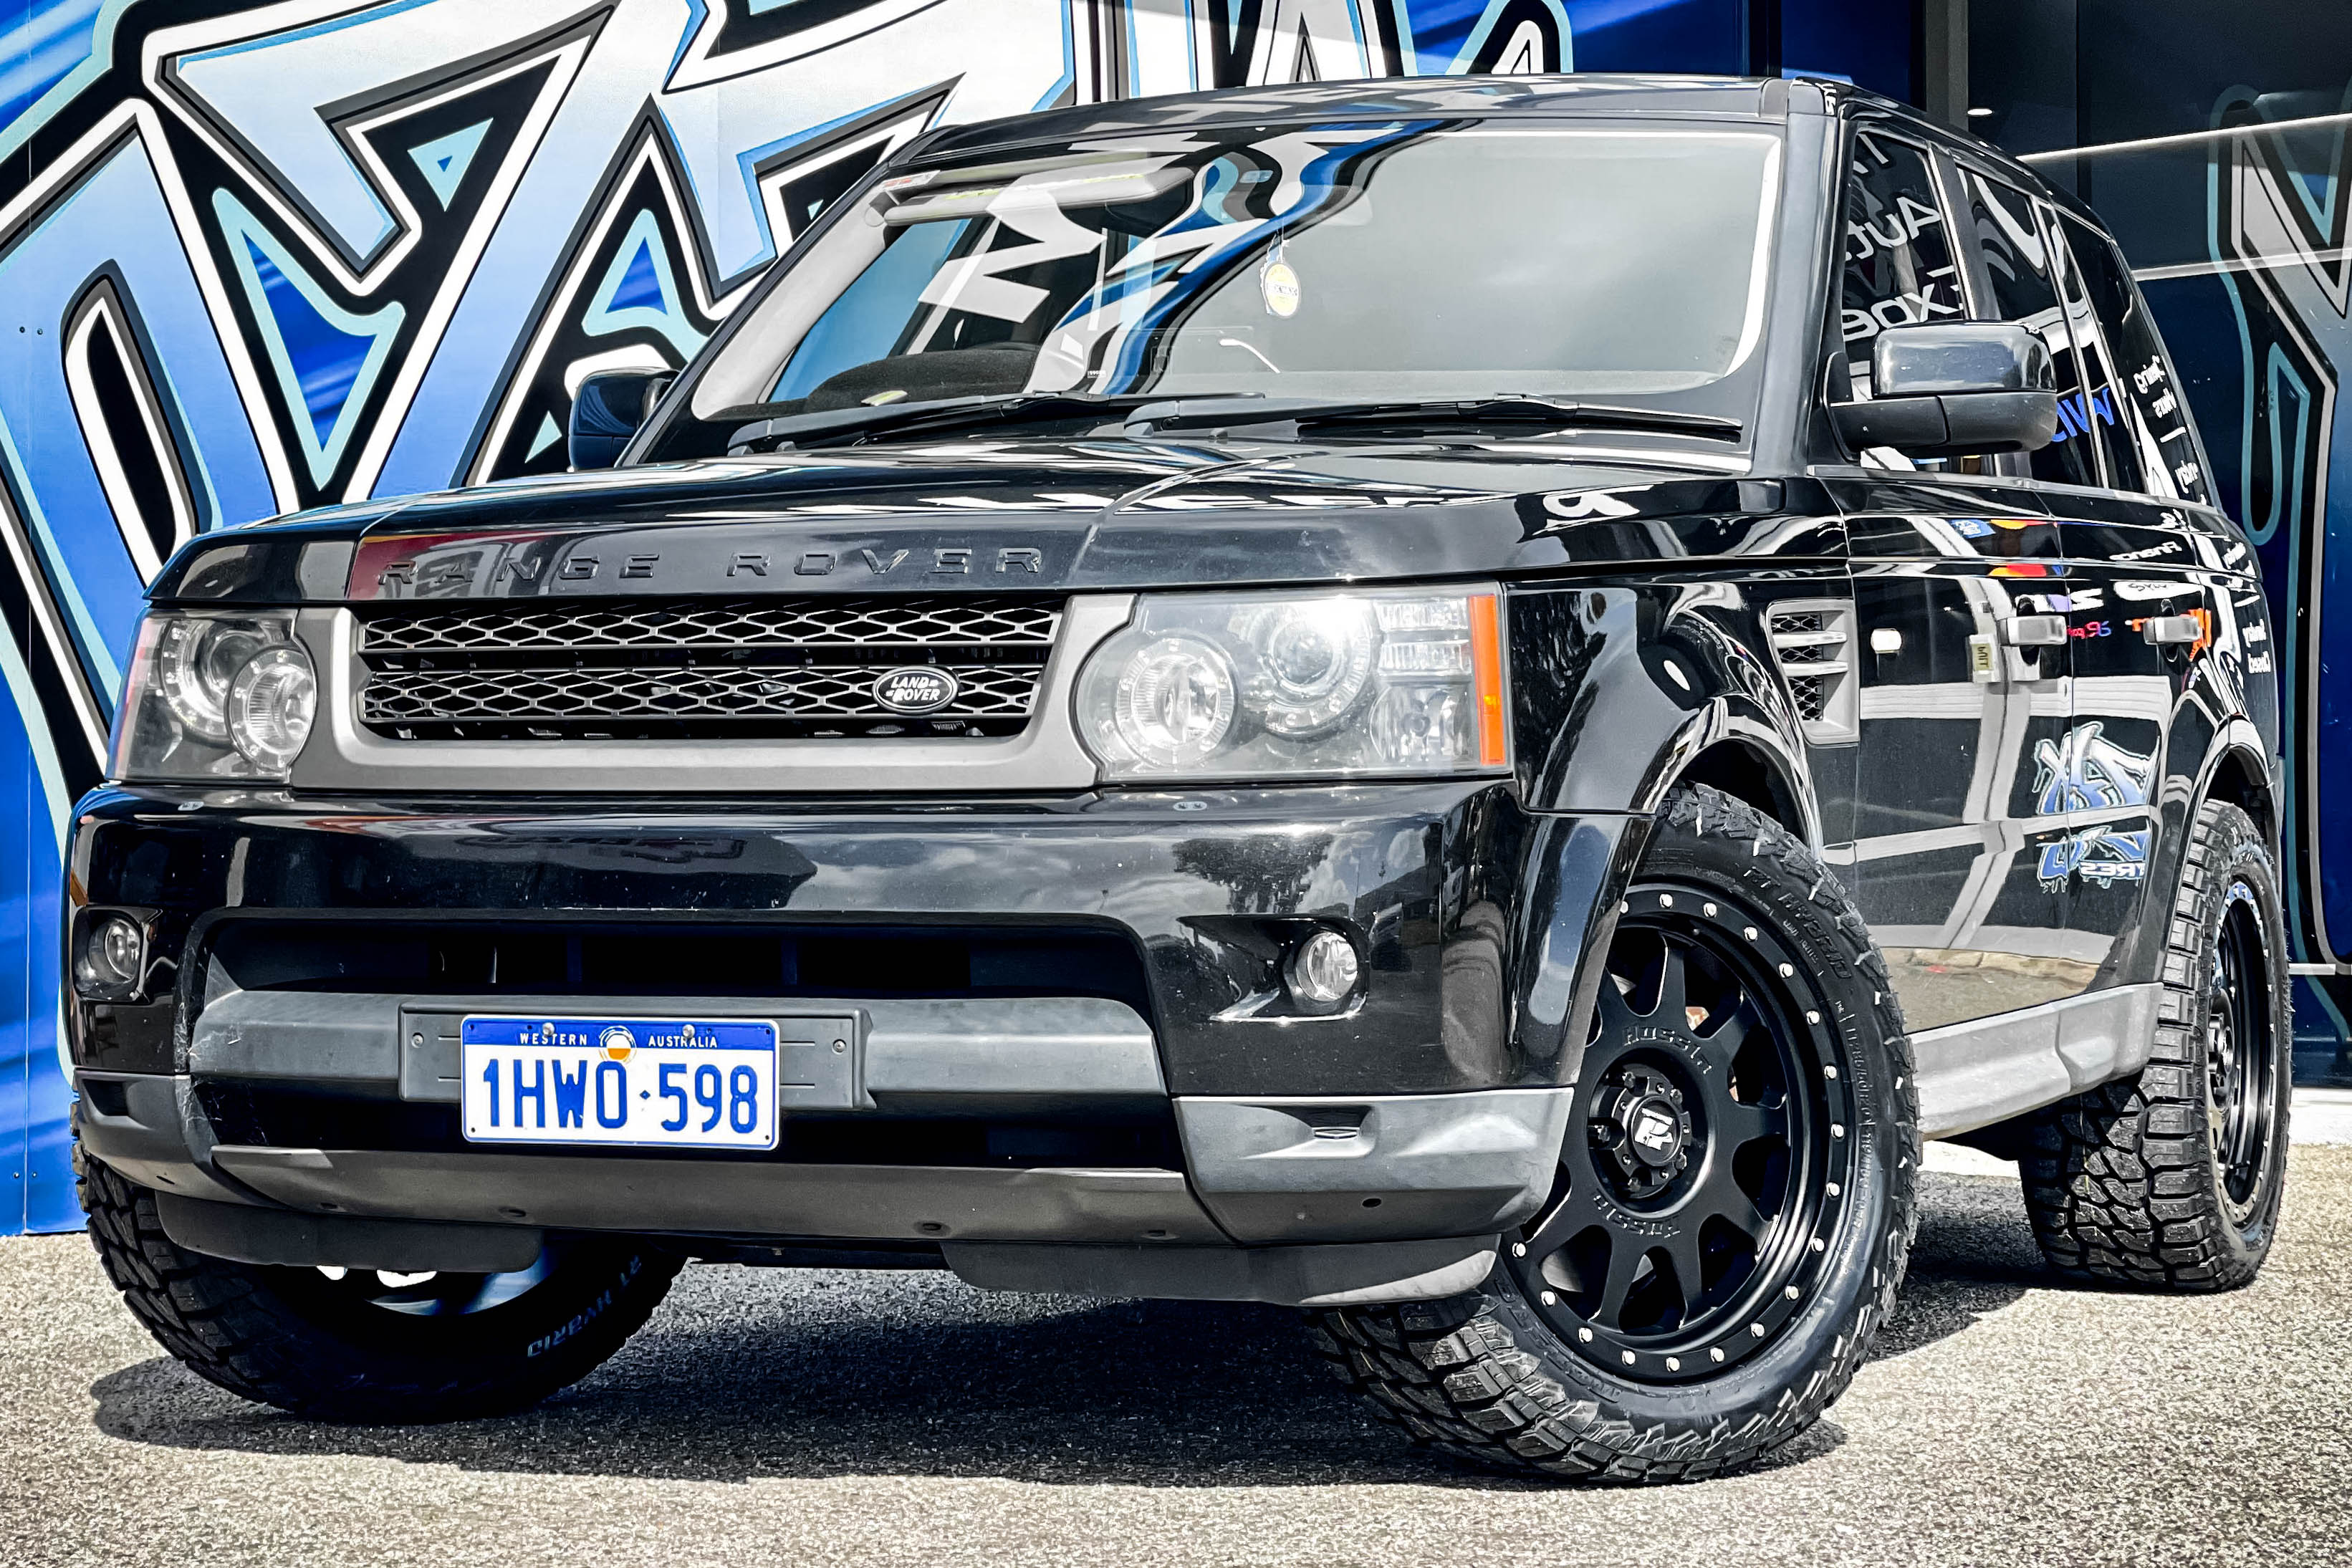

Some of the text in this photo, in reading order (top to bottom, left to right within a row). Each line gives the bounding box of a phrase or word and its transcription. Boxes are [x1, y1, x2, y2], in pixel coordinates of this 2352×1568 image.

[378, 547, 1043, 586] RANGE ROVER
[891, 676, 930, 689] LAND
[892, 688, 941, 702] ROVER
[1777, 892, 1853, 980] HYBRID
[519, 1032, 718, 1049] WESTERN AUSTRALIA
[526, 1289, 613, 1358] HYBRID
